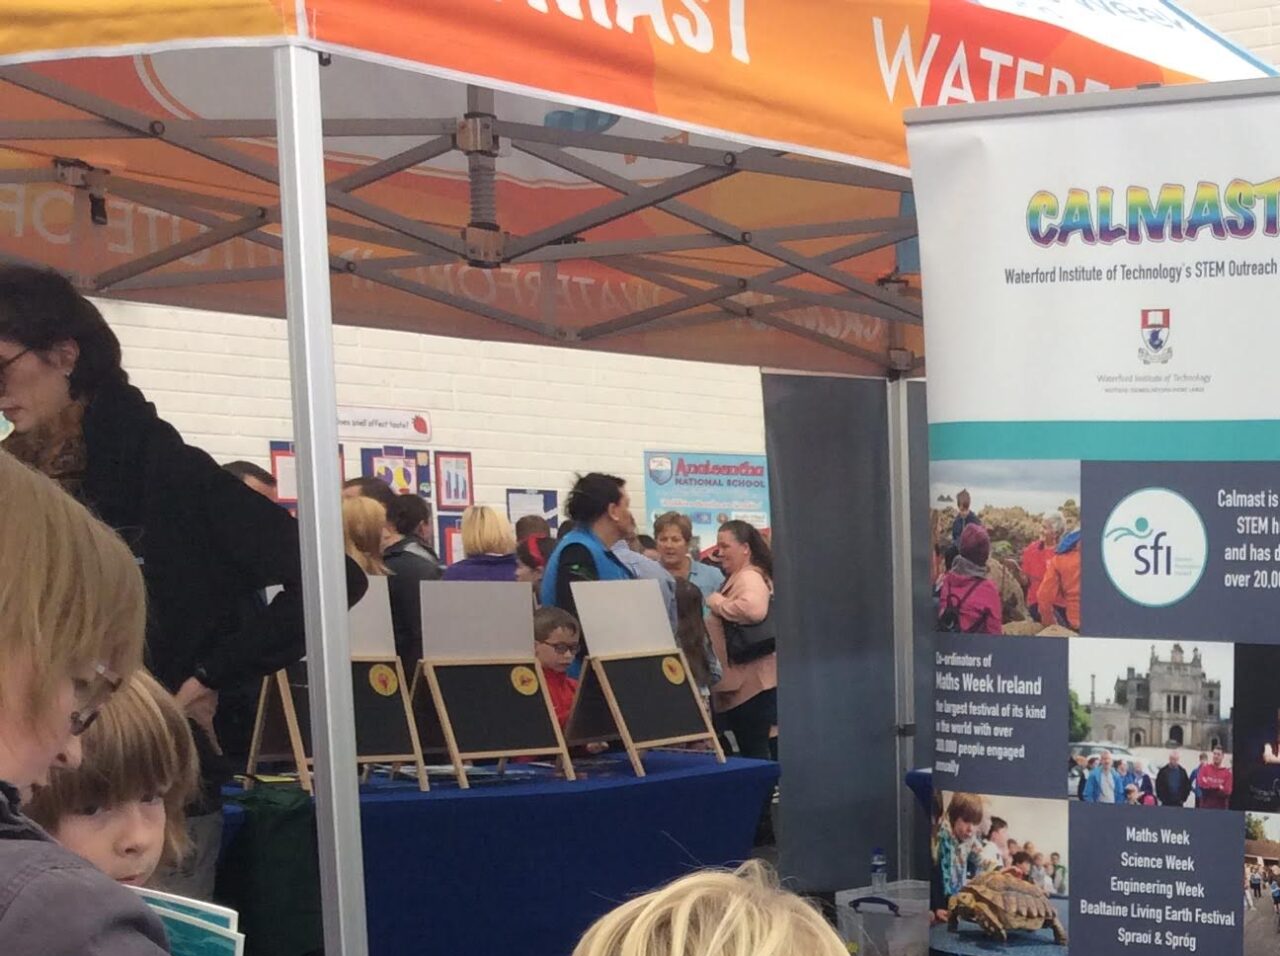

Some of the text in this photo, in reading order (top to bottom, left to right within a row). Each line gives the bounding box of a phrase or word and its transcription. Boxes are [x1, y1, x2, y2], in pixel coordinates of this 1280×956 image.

[1005, 266, 1056, 284] Waterford
[1058, 265, 1102, 282] Institute
[1106, 264, 1119, 281] of
[1120, 262, 1192, 283] Technology's
[1195, 260, 1225, 278] STEM
[1228, 258, 1277, 277] Outreach
[675, 478, 766, 489] NATIONAL SCHOOL
[1218, 489, 1266, 508] Calmast
[1268, 490, 1279, 508] is
[1236, 517, 1268, 535] STEM
[1224, 544, 1247, 561] and
[1249, 545, 1271, 561] has
[1224, 573, 1251, 587] over
[983, 654, 992, 668] of
[962, 673, 994, 693] Week
[997, 675, 1042, 695] Ireland
[969, 702, 999, 716] festival
[1001, 704, 1011, 717] of
[1012, 704, 1024, 718] its
[1025, 705, 1046, 719] kind
[951, 721, 972, 735] world
[973, 722, 992, 736] with
[993, 726, 1014, 737] over
[958, 742, 985, 757] people
[987, 744, 1025, 761] engaged
[1126, 826, 1190, 846] Maths Week
[1121, 852, 1195, 872] Science Week
[1110, 876, 1205, 899] Engineering Week
[1080, 899, 1235, 926] Bealtaine Living Earth Festival
[1118, 927, 1152, 946] Spraoi
[1154, 932, 1163, 945] &
